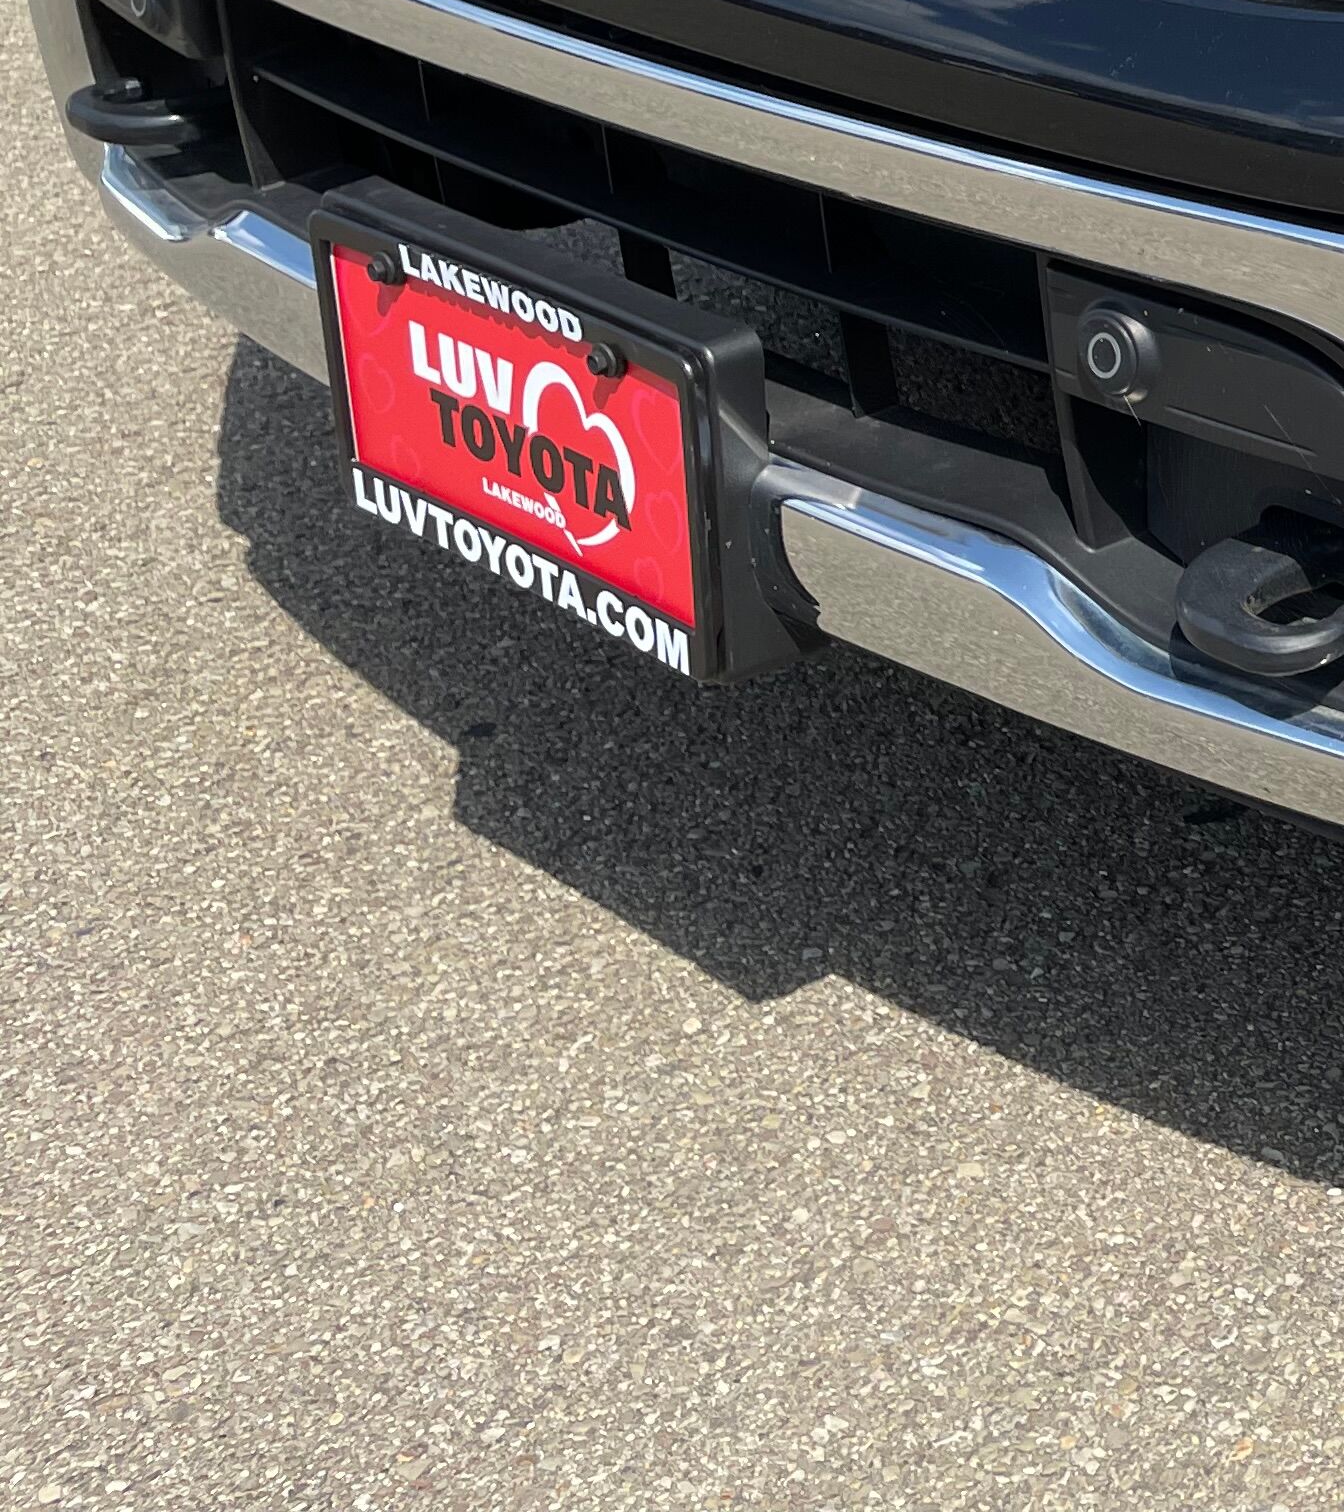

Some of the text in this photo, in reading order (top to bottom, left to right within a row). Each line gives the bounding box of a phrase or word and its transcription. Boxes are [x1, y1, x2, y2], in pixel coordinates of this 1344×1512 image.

[398, 243, 583, 342] LAKEWOOD
[408, 319, 514, 415] LUV
[429, 388, 632, 531] TOYOTA
[482, 477, 566, 529] LAKEWOOD
[352, 467, 690, 676] LUVTOYOTA.COM
